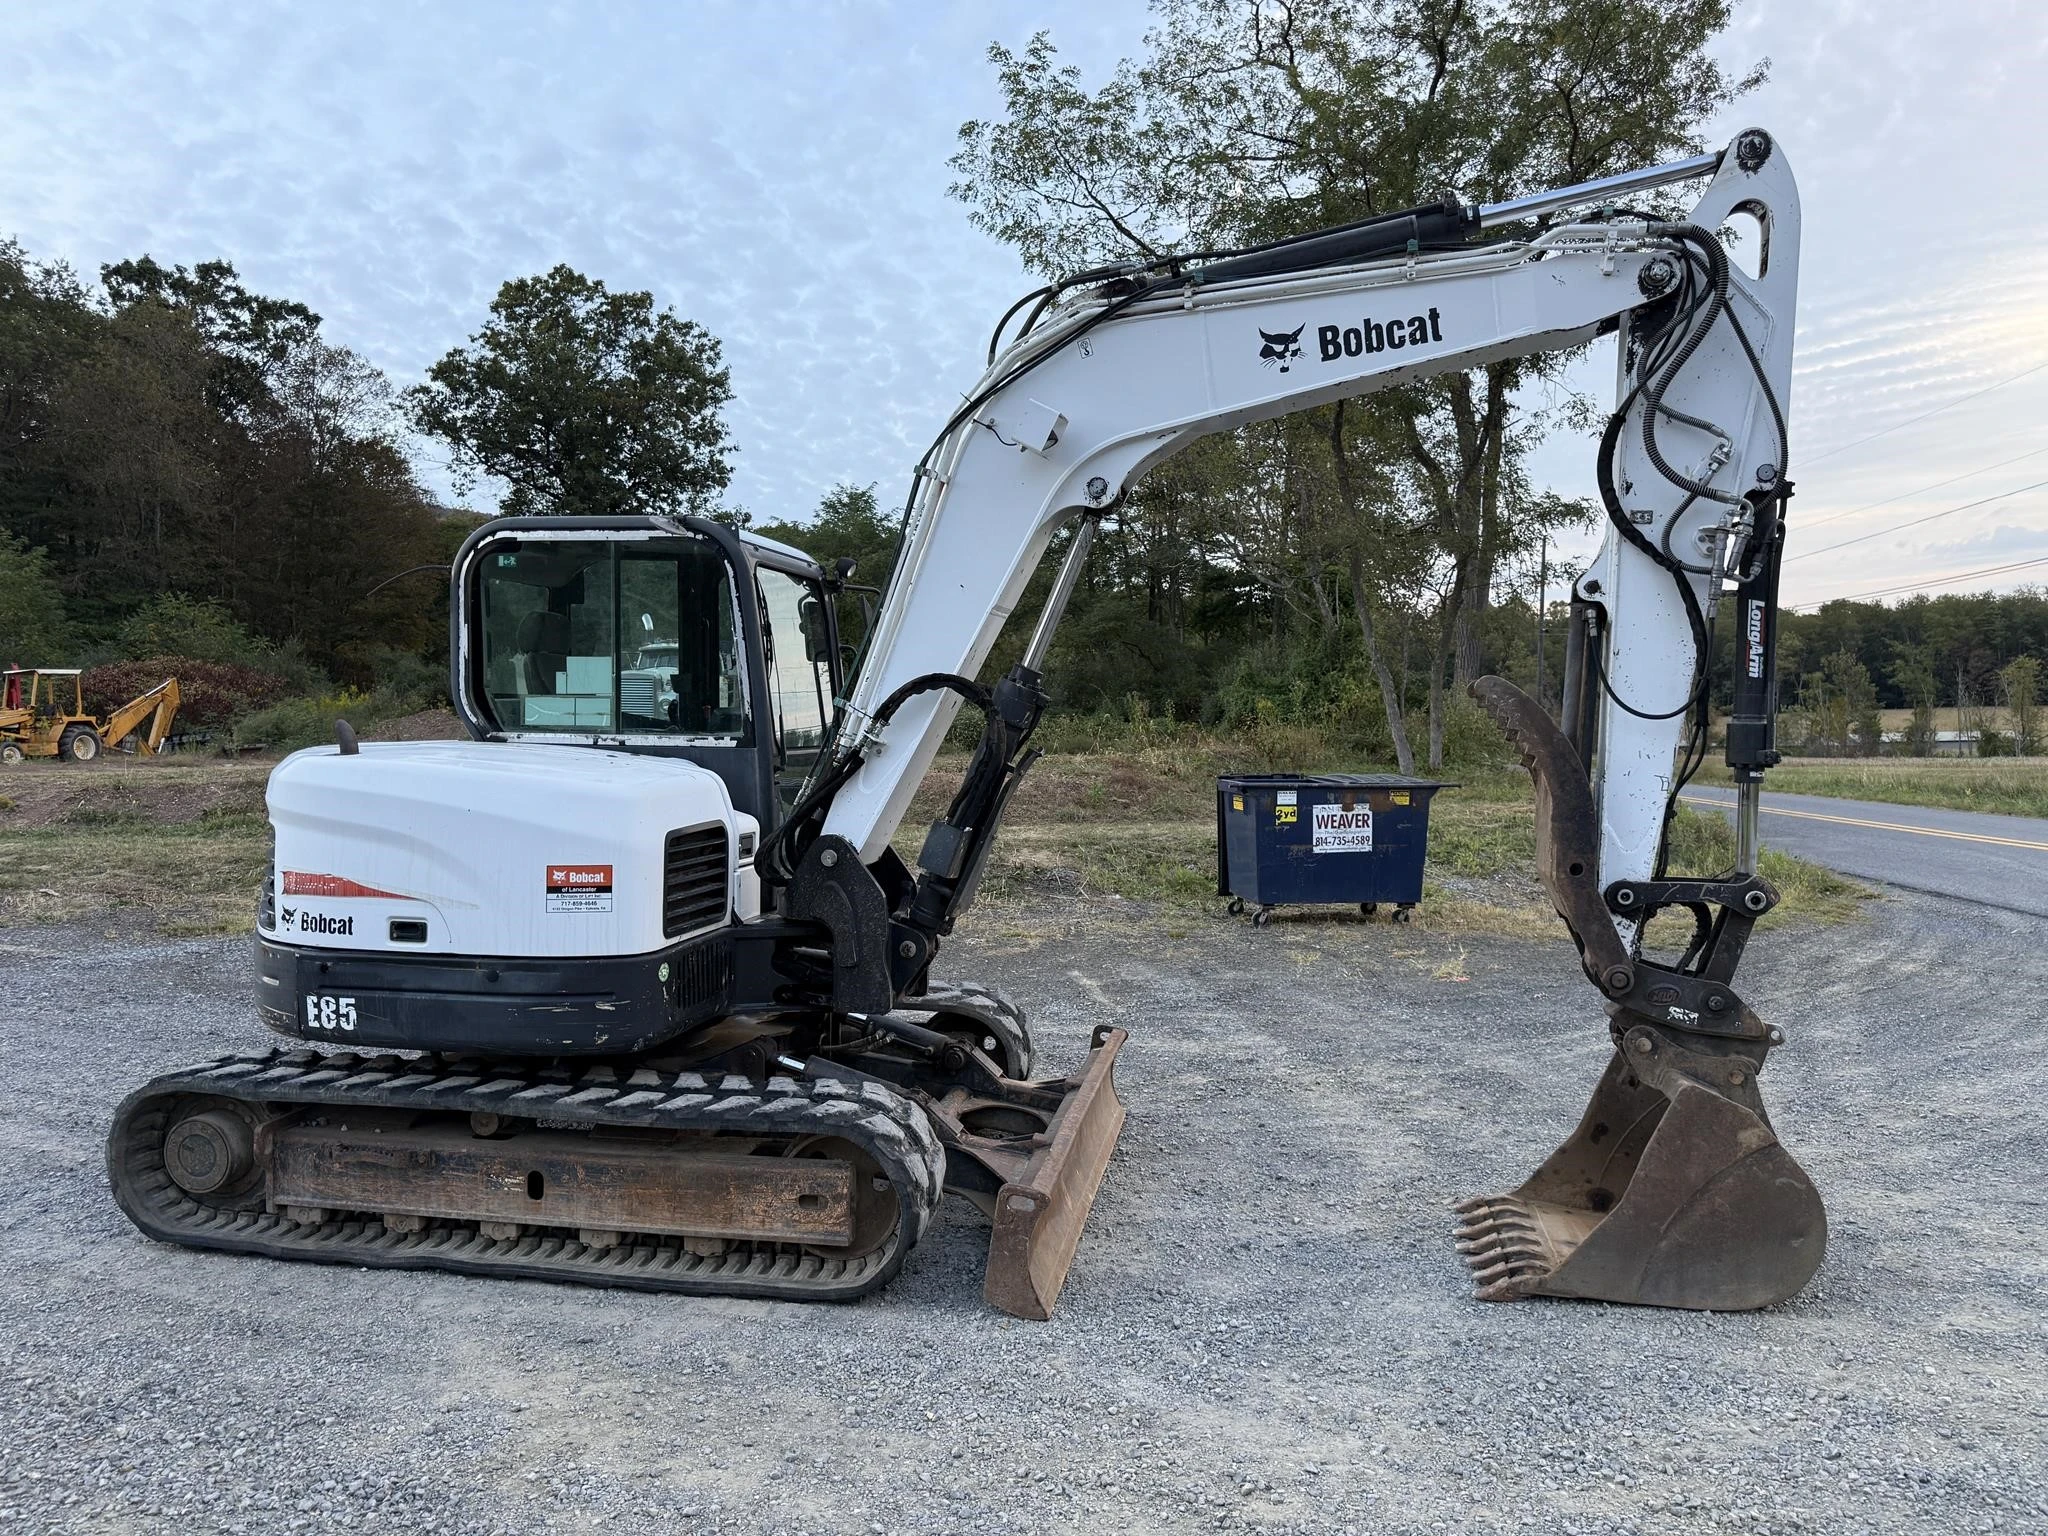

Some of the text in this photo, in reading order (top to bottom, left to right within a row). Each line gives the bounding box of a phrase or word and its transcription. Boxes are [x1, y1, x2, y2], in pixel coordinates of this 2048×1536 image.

[1318, 307, 1443, 362] Bobcat
[1747, 600, 1765, 678] LongArm
[1276, 808, 1297, 819] 2yd
[1316, 813, 1370, 830] WEAVER
[1315, 836, 1370, 847] 814-735-4589
[569, 871, 604, 883] Bobcat
[301, 911, 354, 936] Bobcat
[306, 995, 358, 1031] E85
